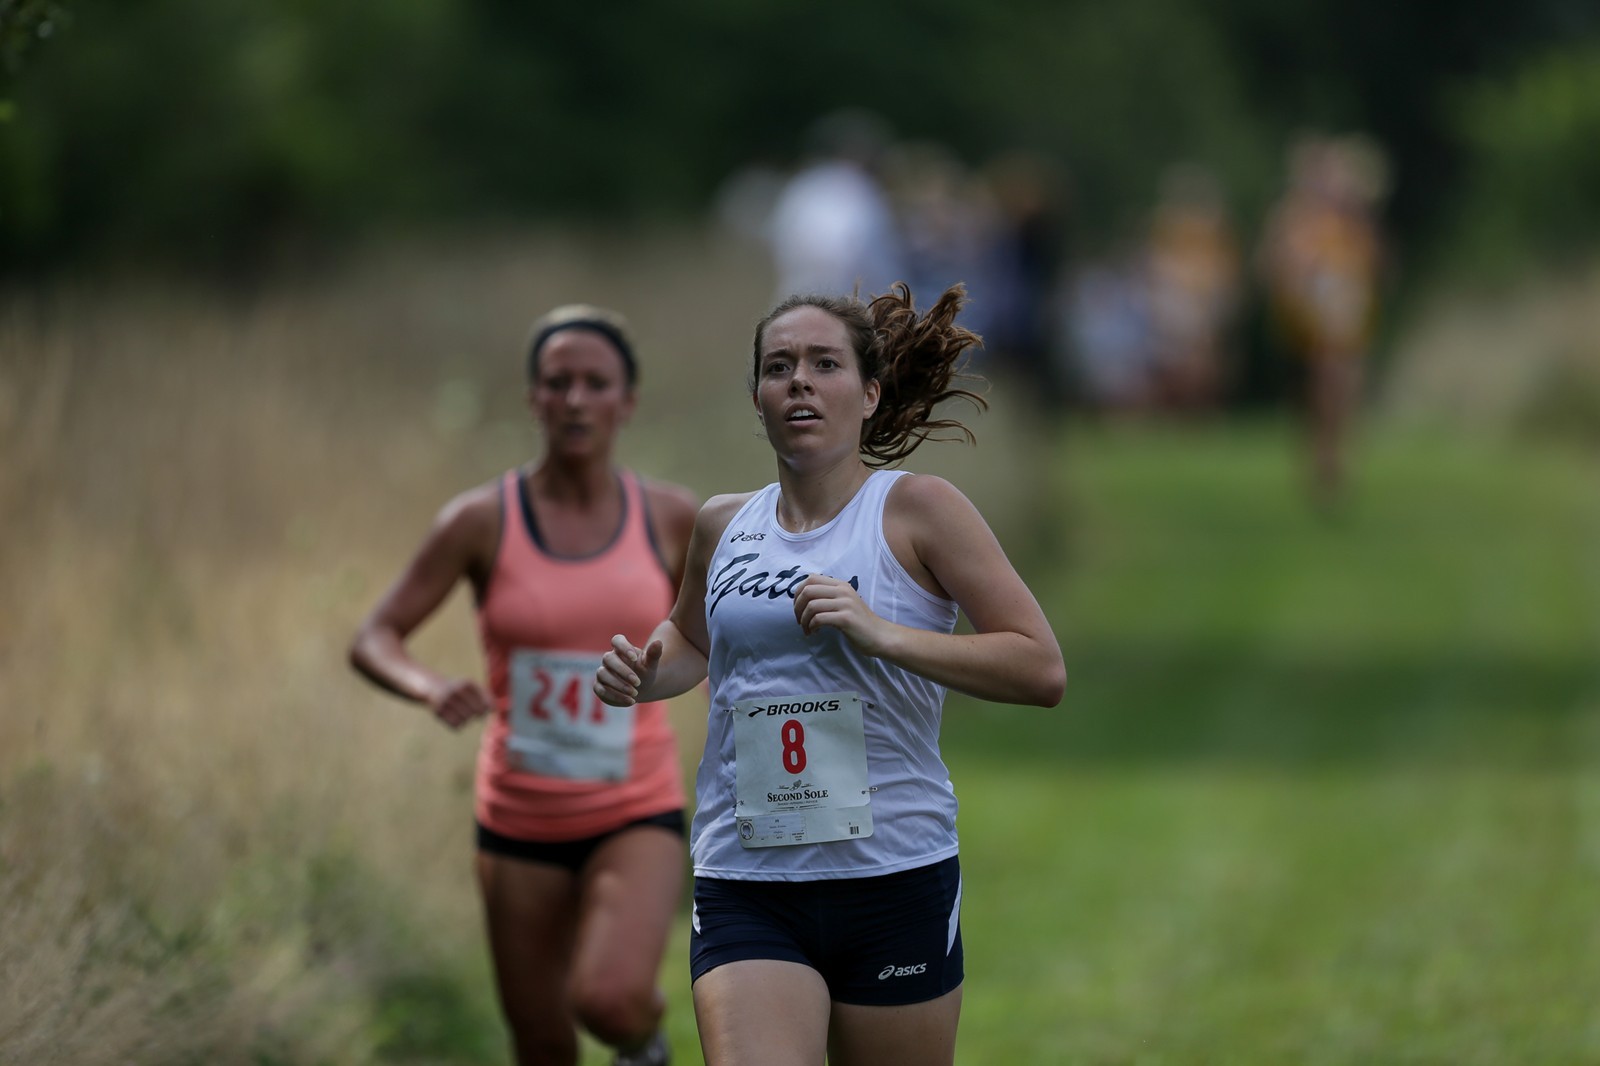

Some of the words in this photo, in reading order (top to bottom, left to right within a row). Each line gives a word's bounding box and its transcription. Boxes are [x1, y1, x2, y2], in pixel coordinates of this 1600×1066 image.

[709, 552, 861, 618] Gate
[766, 700, 840, 716] BROOKS
[781, 719, 807, 775] 8
[767, 791, 802, 803] SECOND
[804, 789, 829, 800] SOLE
[894, 962, 927, 977] asics
